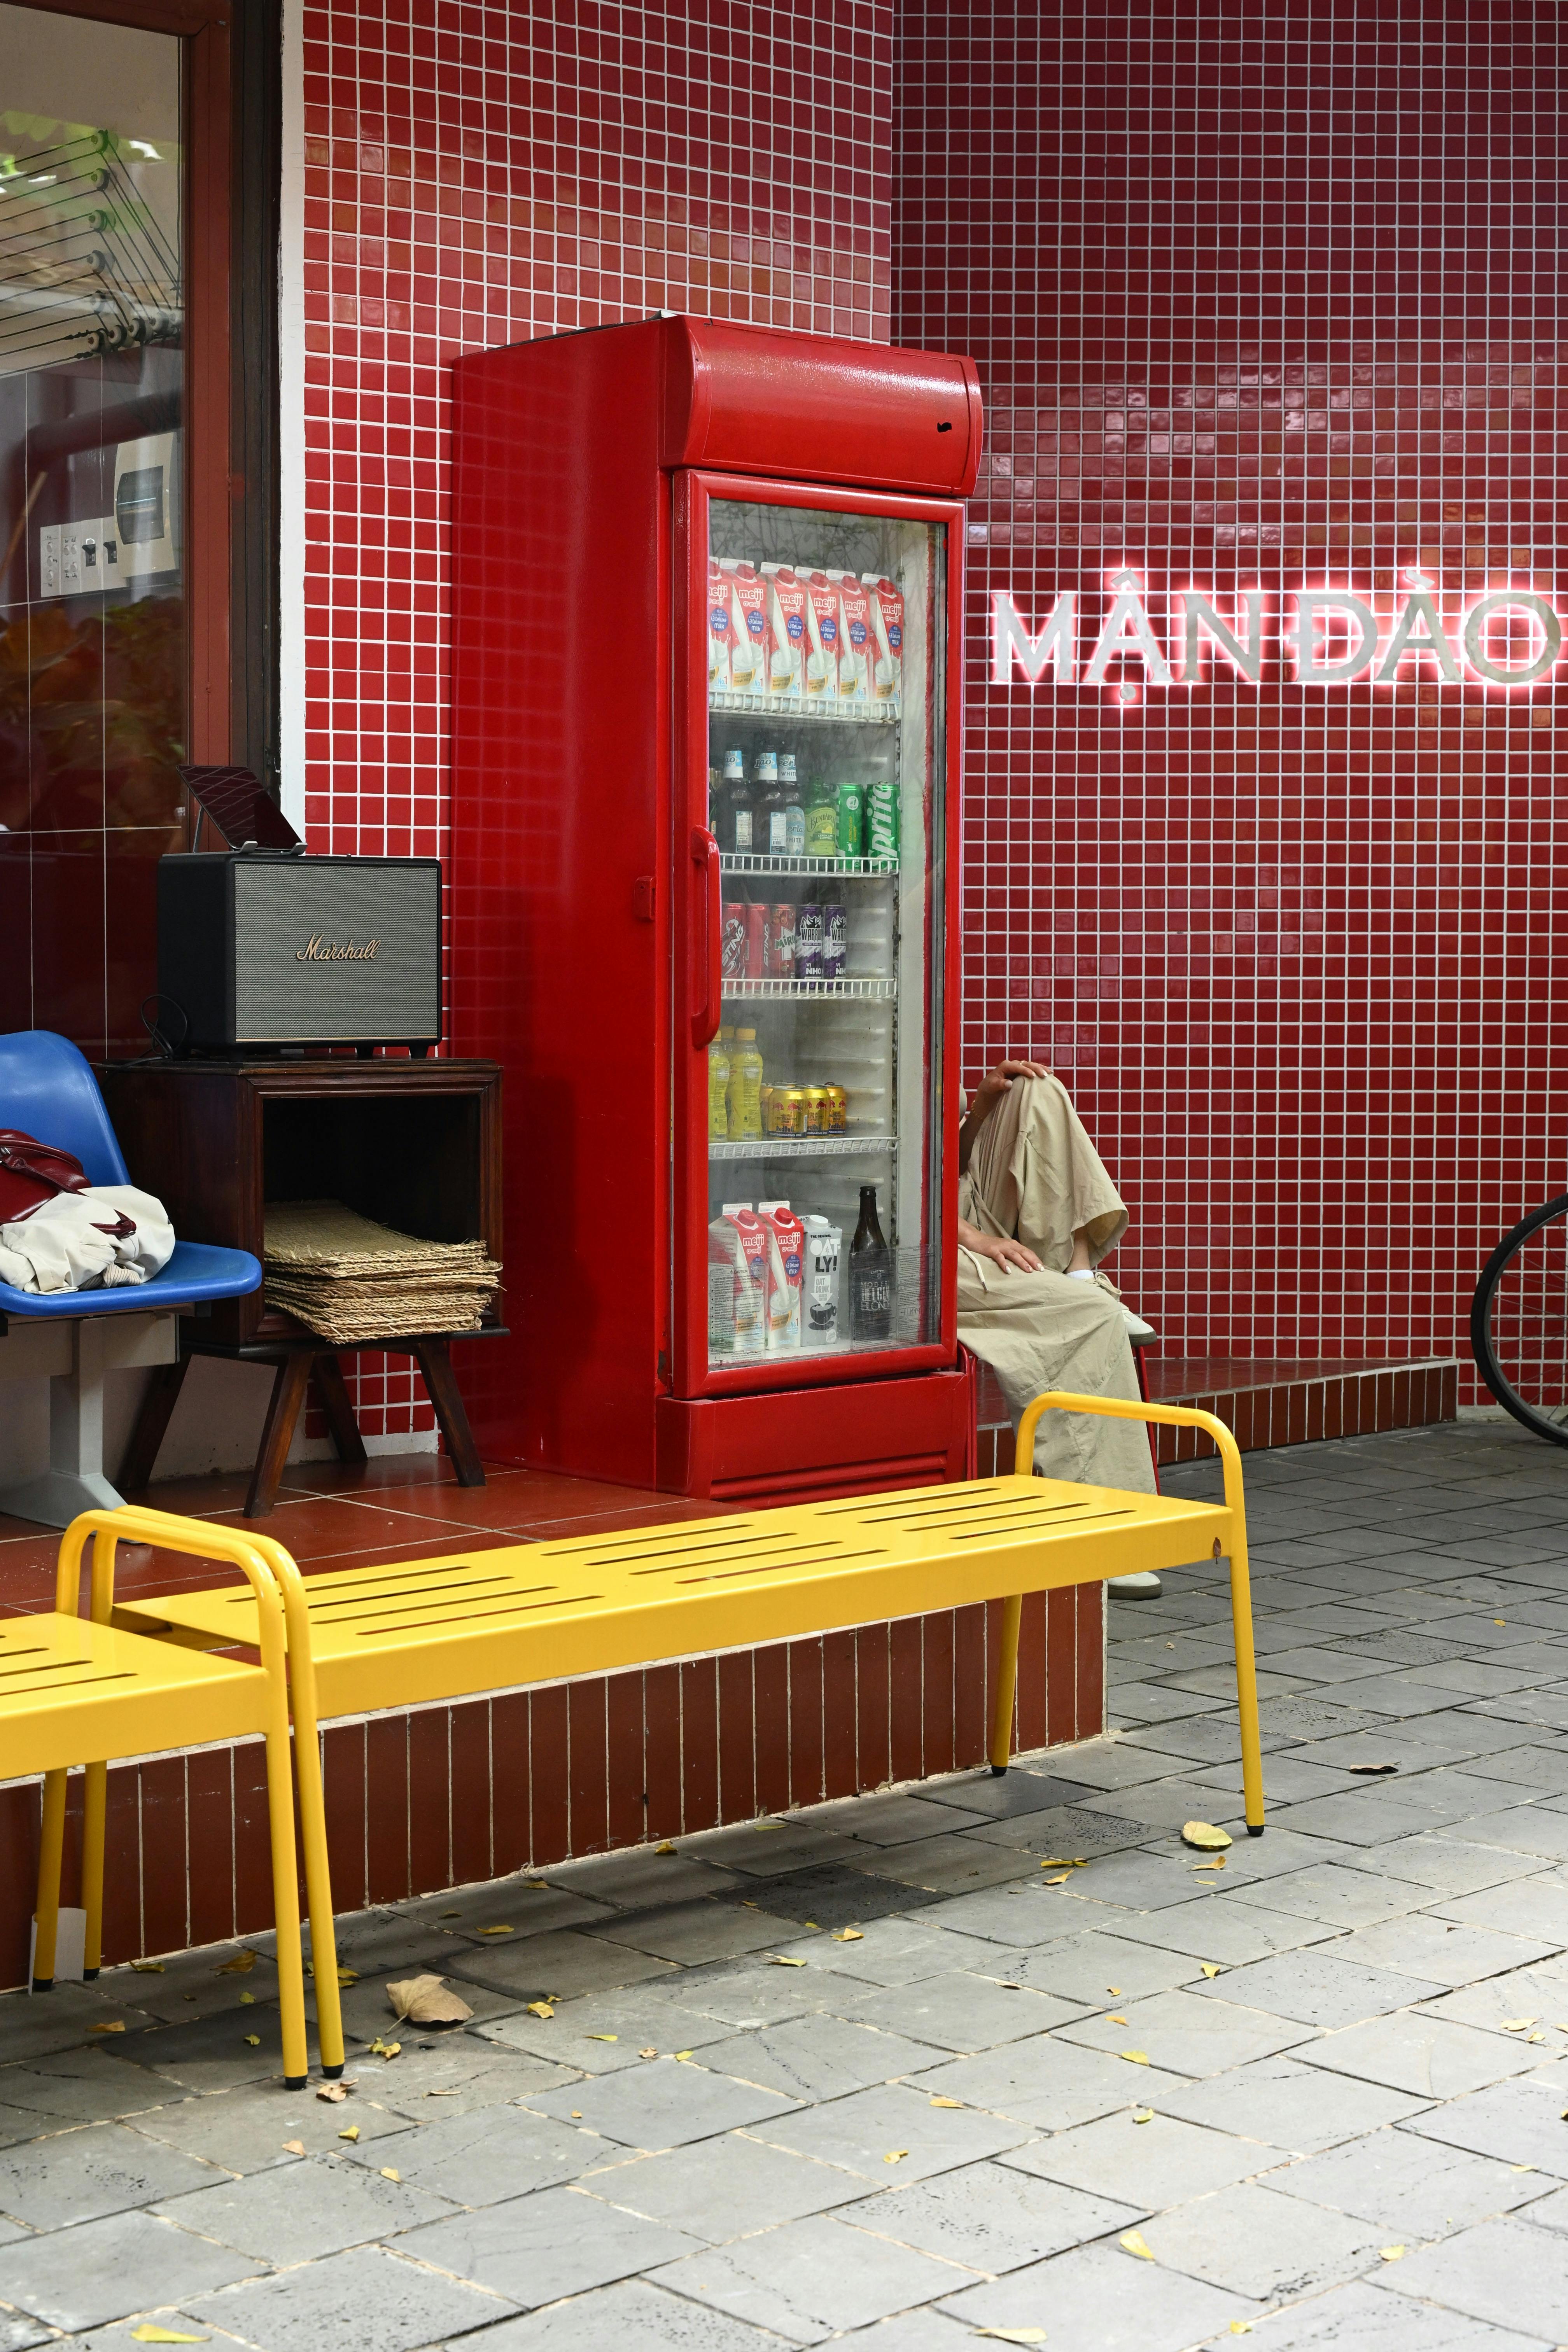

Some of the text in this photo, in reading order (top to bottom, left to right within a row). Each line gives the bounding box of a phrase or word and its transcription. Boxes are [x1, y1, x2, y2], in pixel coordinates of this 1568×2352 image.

[739, 588, 763, 601] meiji
[780, 593, 803, 607] meiji
[814, 597, 836, 609] meiji
[845, 600, 866, 613] meiji
[882, 604, 901, 616] meiji
[867, 785, 897, 870] Sprite
[296, 934, 381, 960] Marshall
[722, 924, 744, 967] STING
[743, 1234, 764, 1248] meiji
[778, 1232, 800, 1245] meiji
[815, 1256, 837, 1273] LY!
